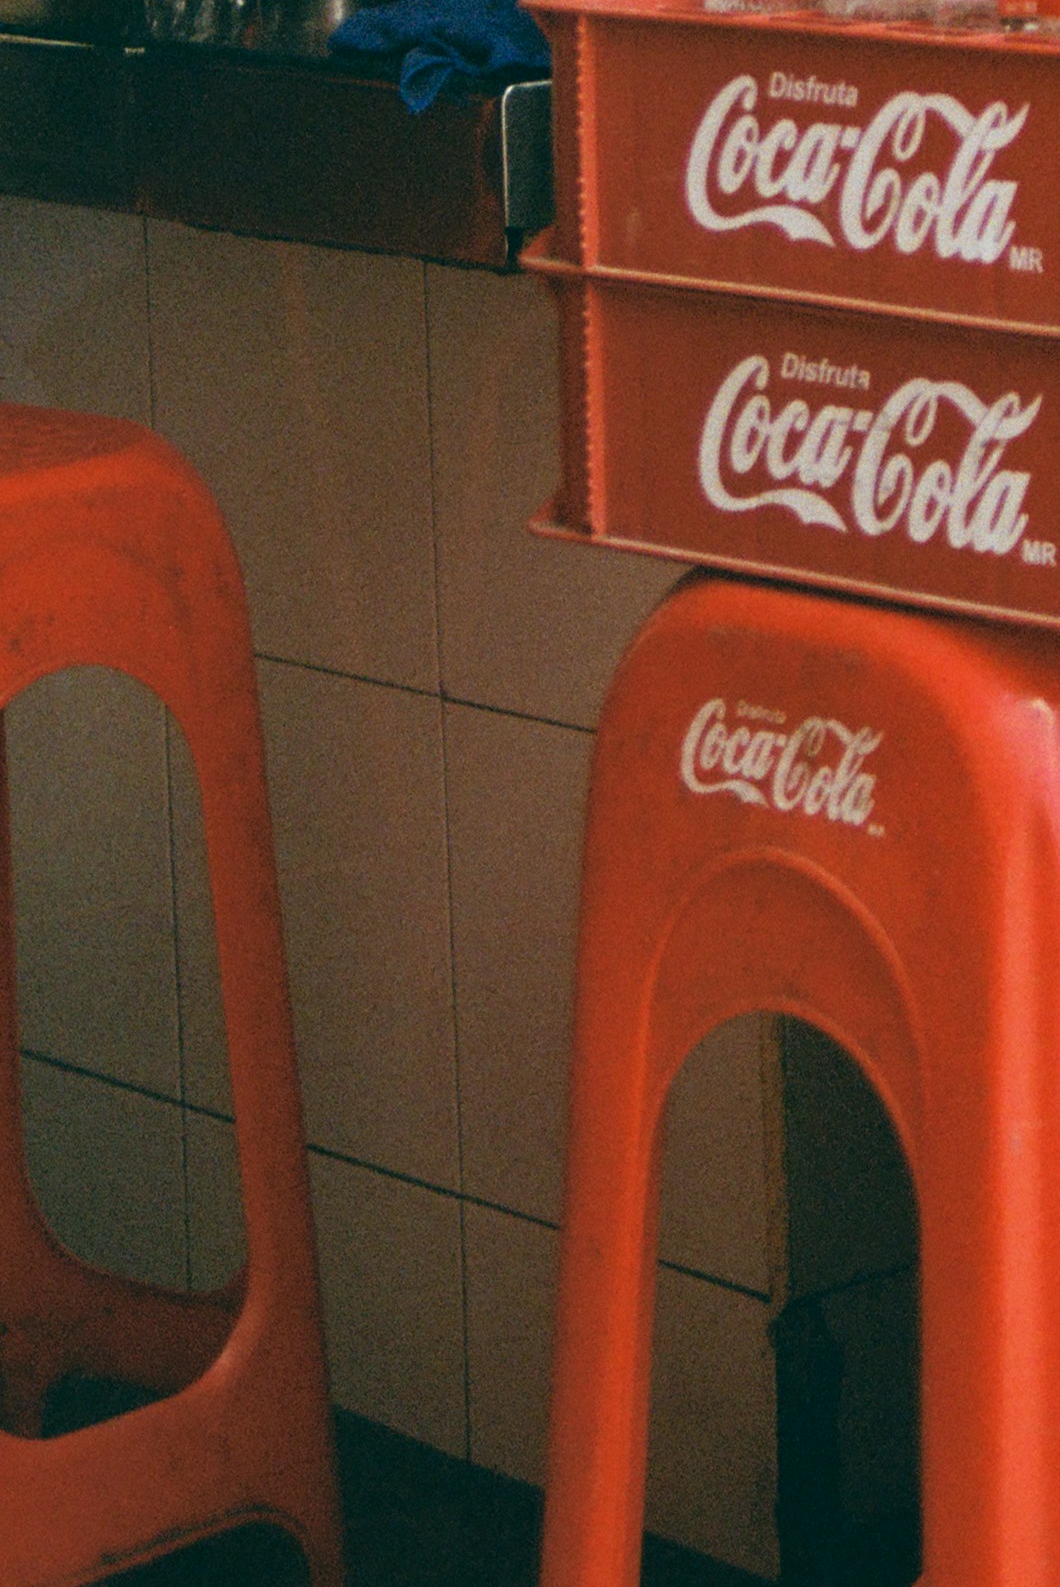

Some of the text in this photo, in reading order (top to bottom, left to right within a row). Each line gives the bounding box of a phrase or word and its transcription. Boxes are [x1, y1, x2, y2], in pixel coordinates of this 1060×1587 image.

[769, 70, 859, 107] Disfruta
[686, 75, 1030, 265] Coca-Cola
[1009, 245, 1044, 273] MR
[780, 352, 872, 391] Disfruta
[699, 355, 1043, 555] Coca-Cola
[1021, 539, 1057, 567] MR
[680, 697, 884, 826] Coca-Cola
